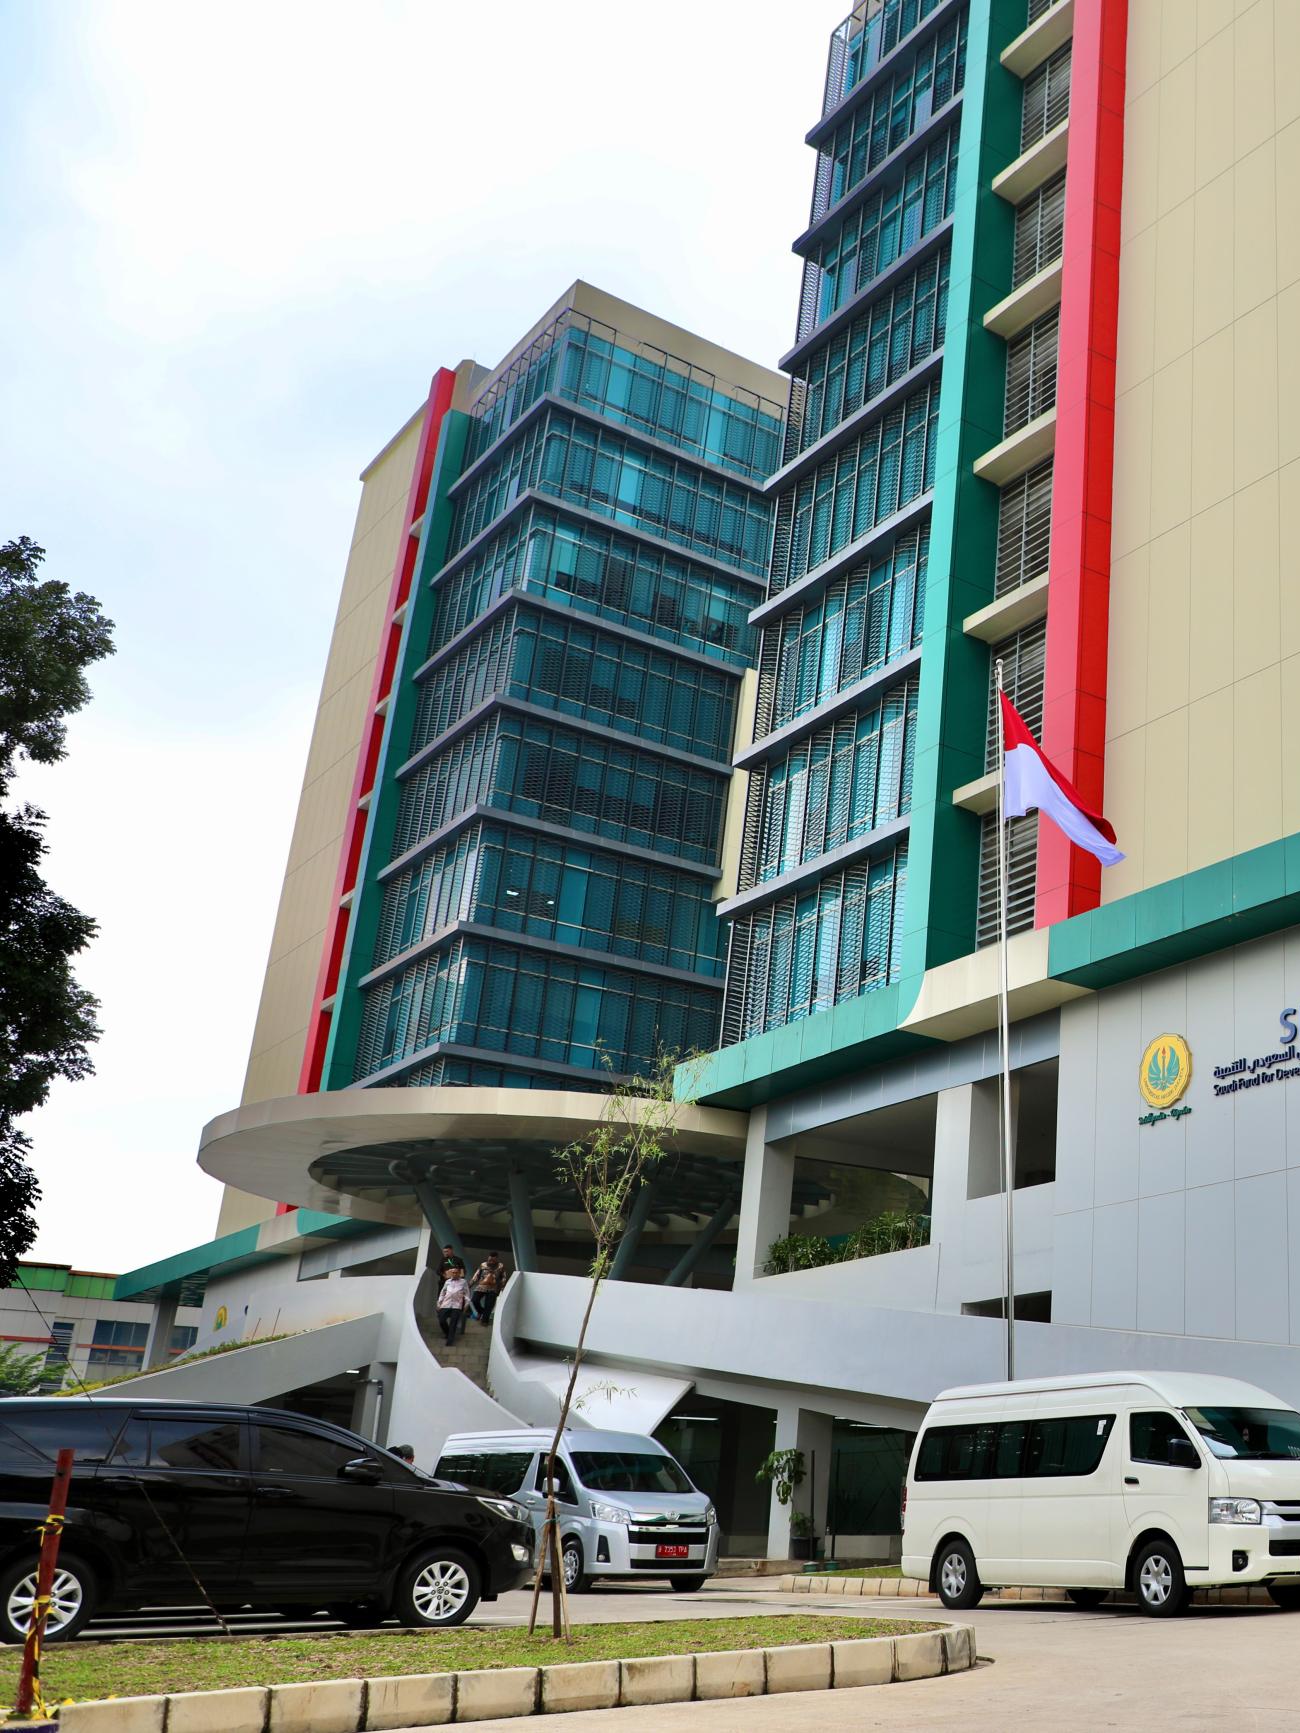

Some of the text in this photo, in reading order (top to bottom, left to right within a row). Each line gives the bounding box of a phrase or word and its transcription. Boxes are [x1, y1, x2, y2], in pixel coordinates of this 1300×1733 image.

[1214, 1079, 1238, 1096] Saudi
[1238, 1073, 1260, 1089] Fund
[1261, 1071, 1275, 1084] for
